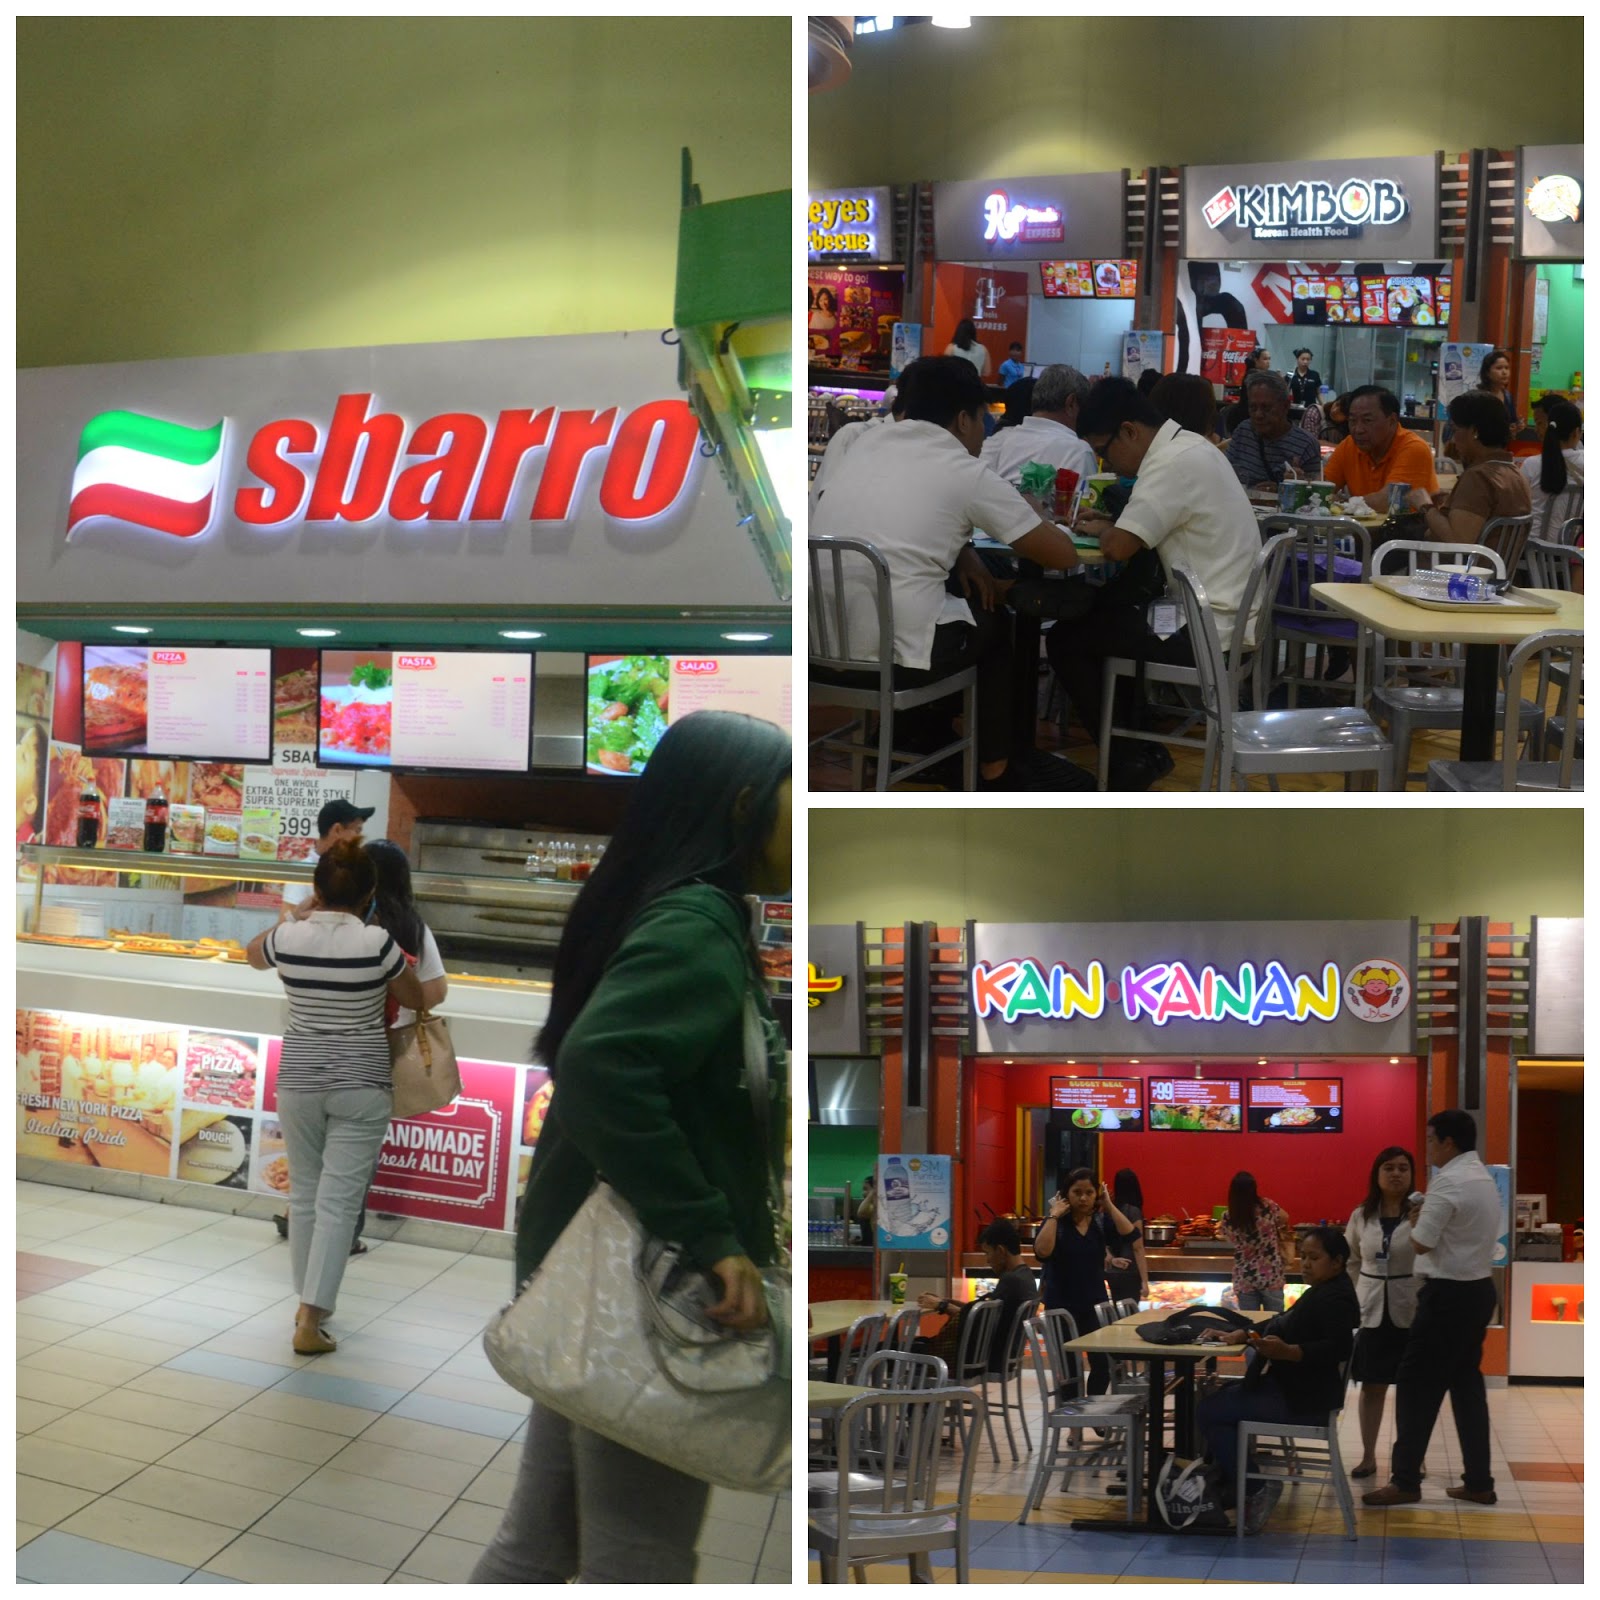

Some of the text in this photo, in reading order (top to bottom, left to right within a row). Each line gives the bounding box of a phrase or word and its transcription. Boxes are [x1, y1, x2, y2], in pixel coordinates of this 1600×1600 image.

[1207, 180, 1405, 226] Mr. KIMBOB
[808, 199, 869, 229] eyes
[1026, 227, 1062, 239] EXPRESS
[1255, 226, 1349, 238] Korean Health Food
[808, 229, 869, 251] becue
[809, 271, 869, 285] est way to go!
[233, 393, 700, 526] sbarro
[156, 652, 183, 661] PIZZA
[401, 656, 433, 667] PASTA
[680, 661, 715, 671] SALAD
[274, 779, 320, 789] ONE WHOLE
[245, 786, 351, 800] EXTRA LARGE NY STYLE
[245, 795, 274, 806] SUPER
[276, 797, 321, 808] SUPREME
[303, 808, 319, 817] COC
[972, 958, 1342, 1027] KAIN KAINAN
[201, 1054, 243, 1074] PIZZA
[1068, 1080, 1100, 1088] BUDGET
[16, 1092, 144, 1121] FRESH NEW YORK PIZZA
[25, 1118, 128, 1146] Italian Pride
[199, 1125, 233, 1144] DOUGH
[382, 1122, 486, 1158] ANDMADE
[380, 1151, 485, 1179] resh ALL DAY
[921, 1159, 941, 1174] SM
[1166, 1502, 1215, 1514] llness
